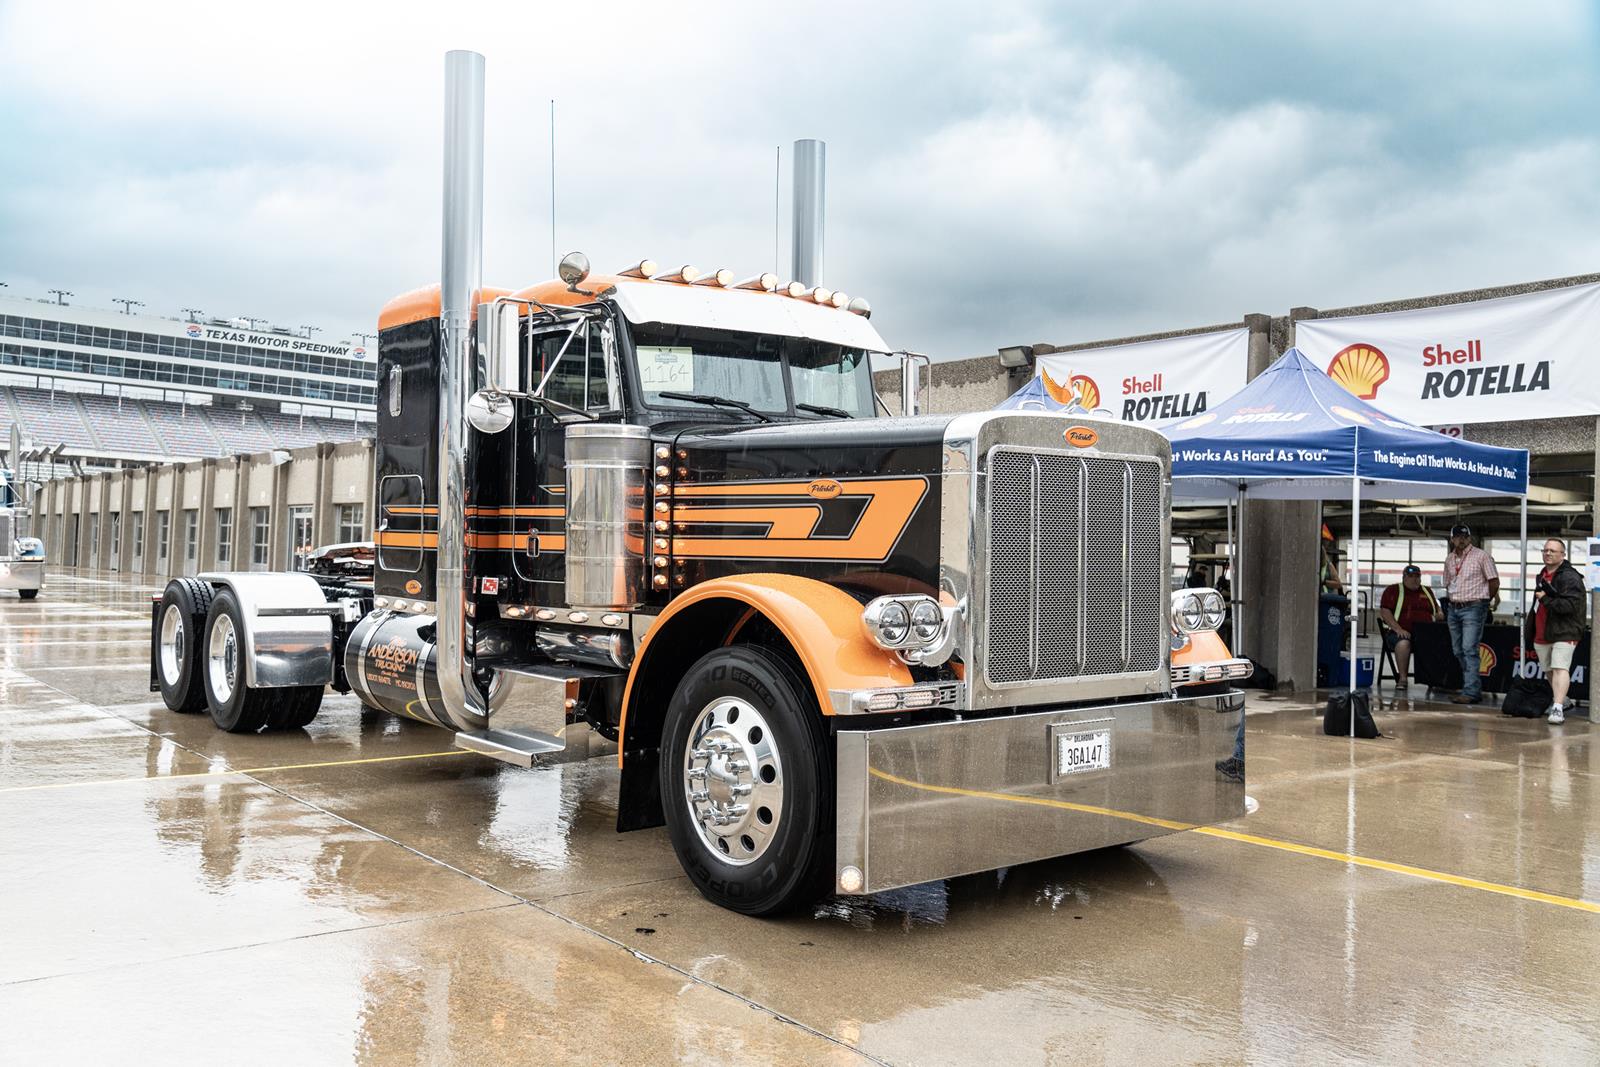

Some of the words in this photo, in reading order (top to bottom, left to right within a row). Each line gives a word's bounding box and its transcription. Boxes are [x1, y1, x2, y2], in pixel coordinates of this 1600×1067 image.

[205, 329, 246, 343] TEXAS
[247, 335, 289, 349] MOTOR
[292, 341, 350, 356] SPEEDWAY
[1422, 339, 1481, 367] Shell
[1122, 373, 1162, 395] Shell
[1420, 361, 1550, 400] ROTELLA
[1121, 391, 1207, 422] ROTELLA
[1182, 448, 1221, 462] Works
[1223, 449, 1239, 462] As
[1242, 448, 1274, 462] Hard
[1277, 449, 1294, 462] As
[1373, 450, 1388, 463] The
[1389, 452, 1416, 468] Engine
[1416, 454, 1427, 467] Oil
[1428, 455, 1444, 468] That
[1444, 457, 1467, 471] Works
[1467, 460, 1477, 473] As
[1477, 462, 1494, 476] Hard
[1494, 465, 1503, 477] As
[368, 644, 420, 665] ANDERSON
[375, 659, 406, 673] TRUCKING
[732, 667, 776, 708] SERIES
[1068, 745, 1102, 766] 3GA147
